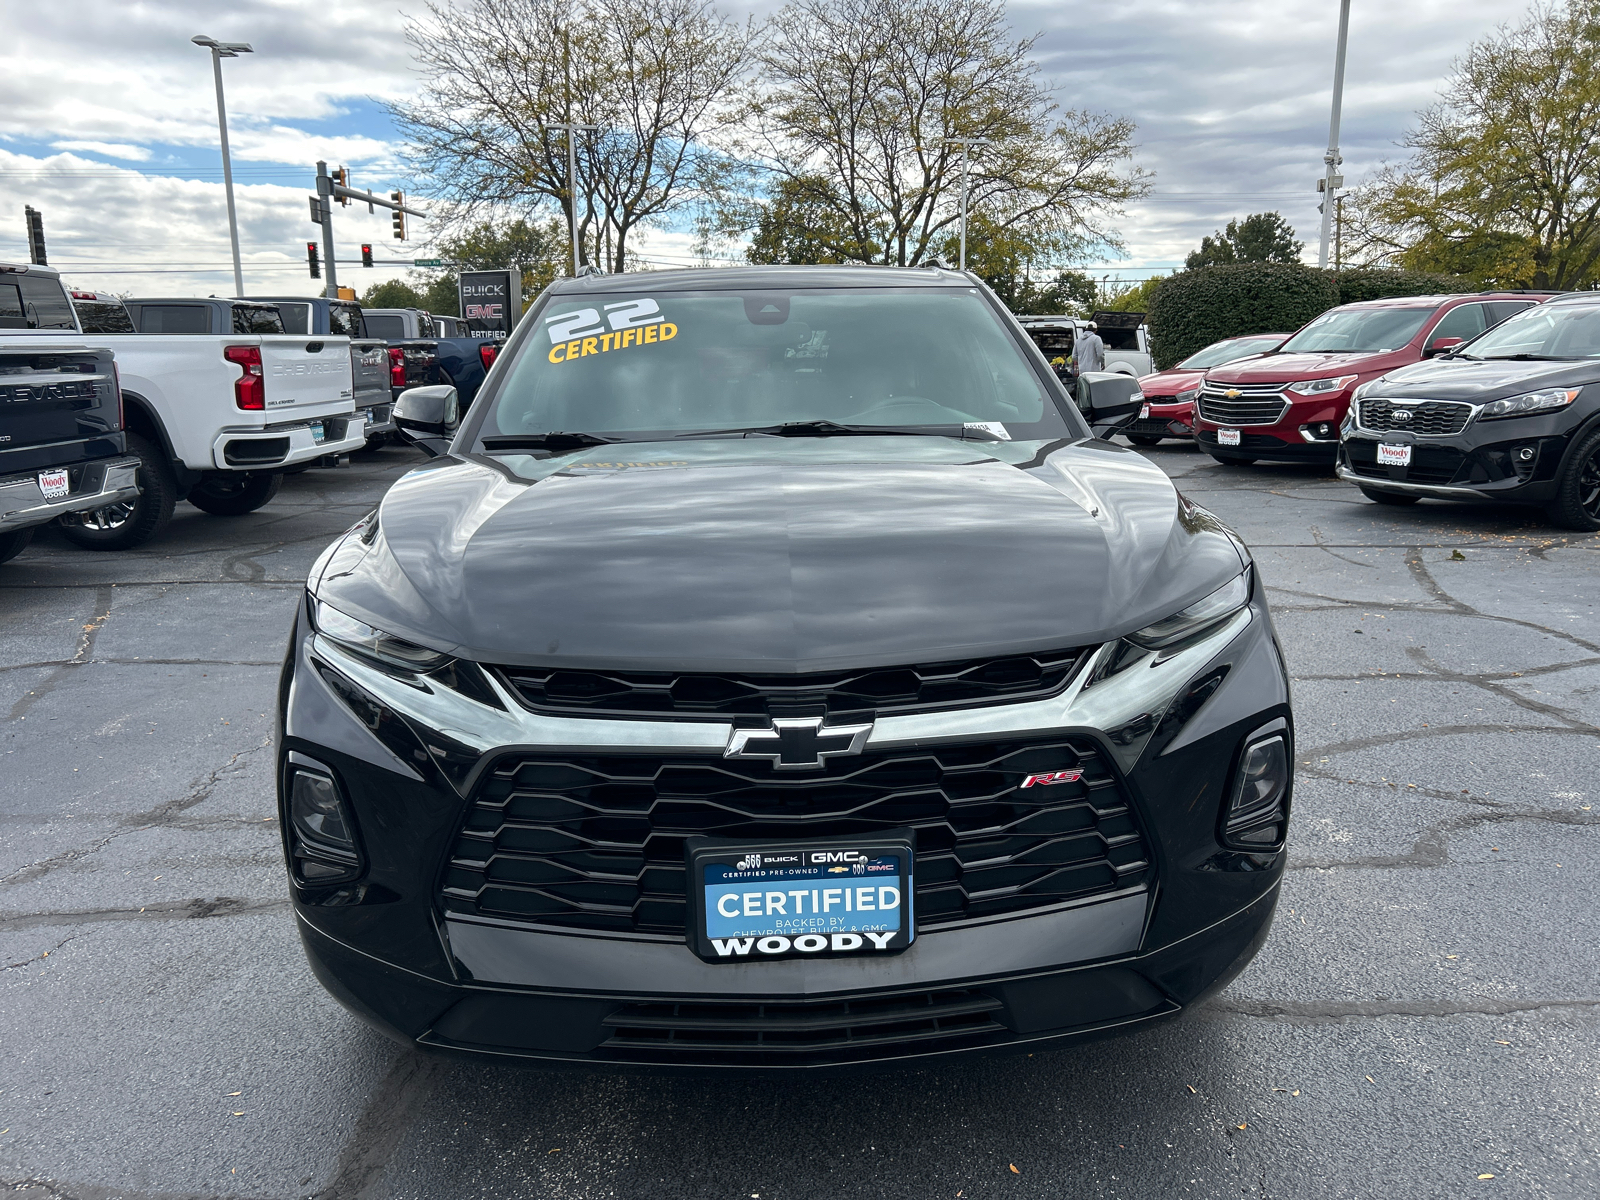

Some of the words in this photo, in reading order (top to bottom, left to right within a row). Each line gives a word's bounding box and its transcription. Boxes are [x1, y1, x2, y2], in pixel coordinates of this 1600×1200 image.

[463, 285, 504, 296] BUICK
[466, 304, 502, 318] GMC
[545, 298, 665, 344] 22
[548, 323, 678, 364] CERTIFIED
[273, 363, 348, 376] CHEVROLET
[1394, 412, 1408, 420] KIA
[1220, 431, 1238, 440] Woody
[1381, 447, 1409, 459] Woody
[41, 475, 66, 488] Woody
[1020, 769, 1084, 788] RS
[764, 855, 798, 863] BUICK
[811, 851, 859, 863] GMC
[769, 868, 818, 876] PRE-OWNED
[717, 886, 900, 918] CERTIFIED
[775, 918, 825, 928] BACKED
[830, 917, 845, 926] BY
[710, 932, 898, 956] WOODY
